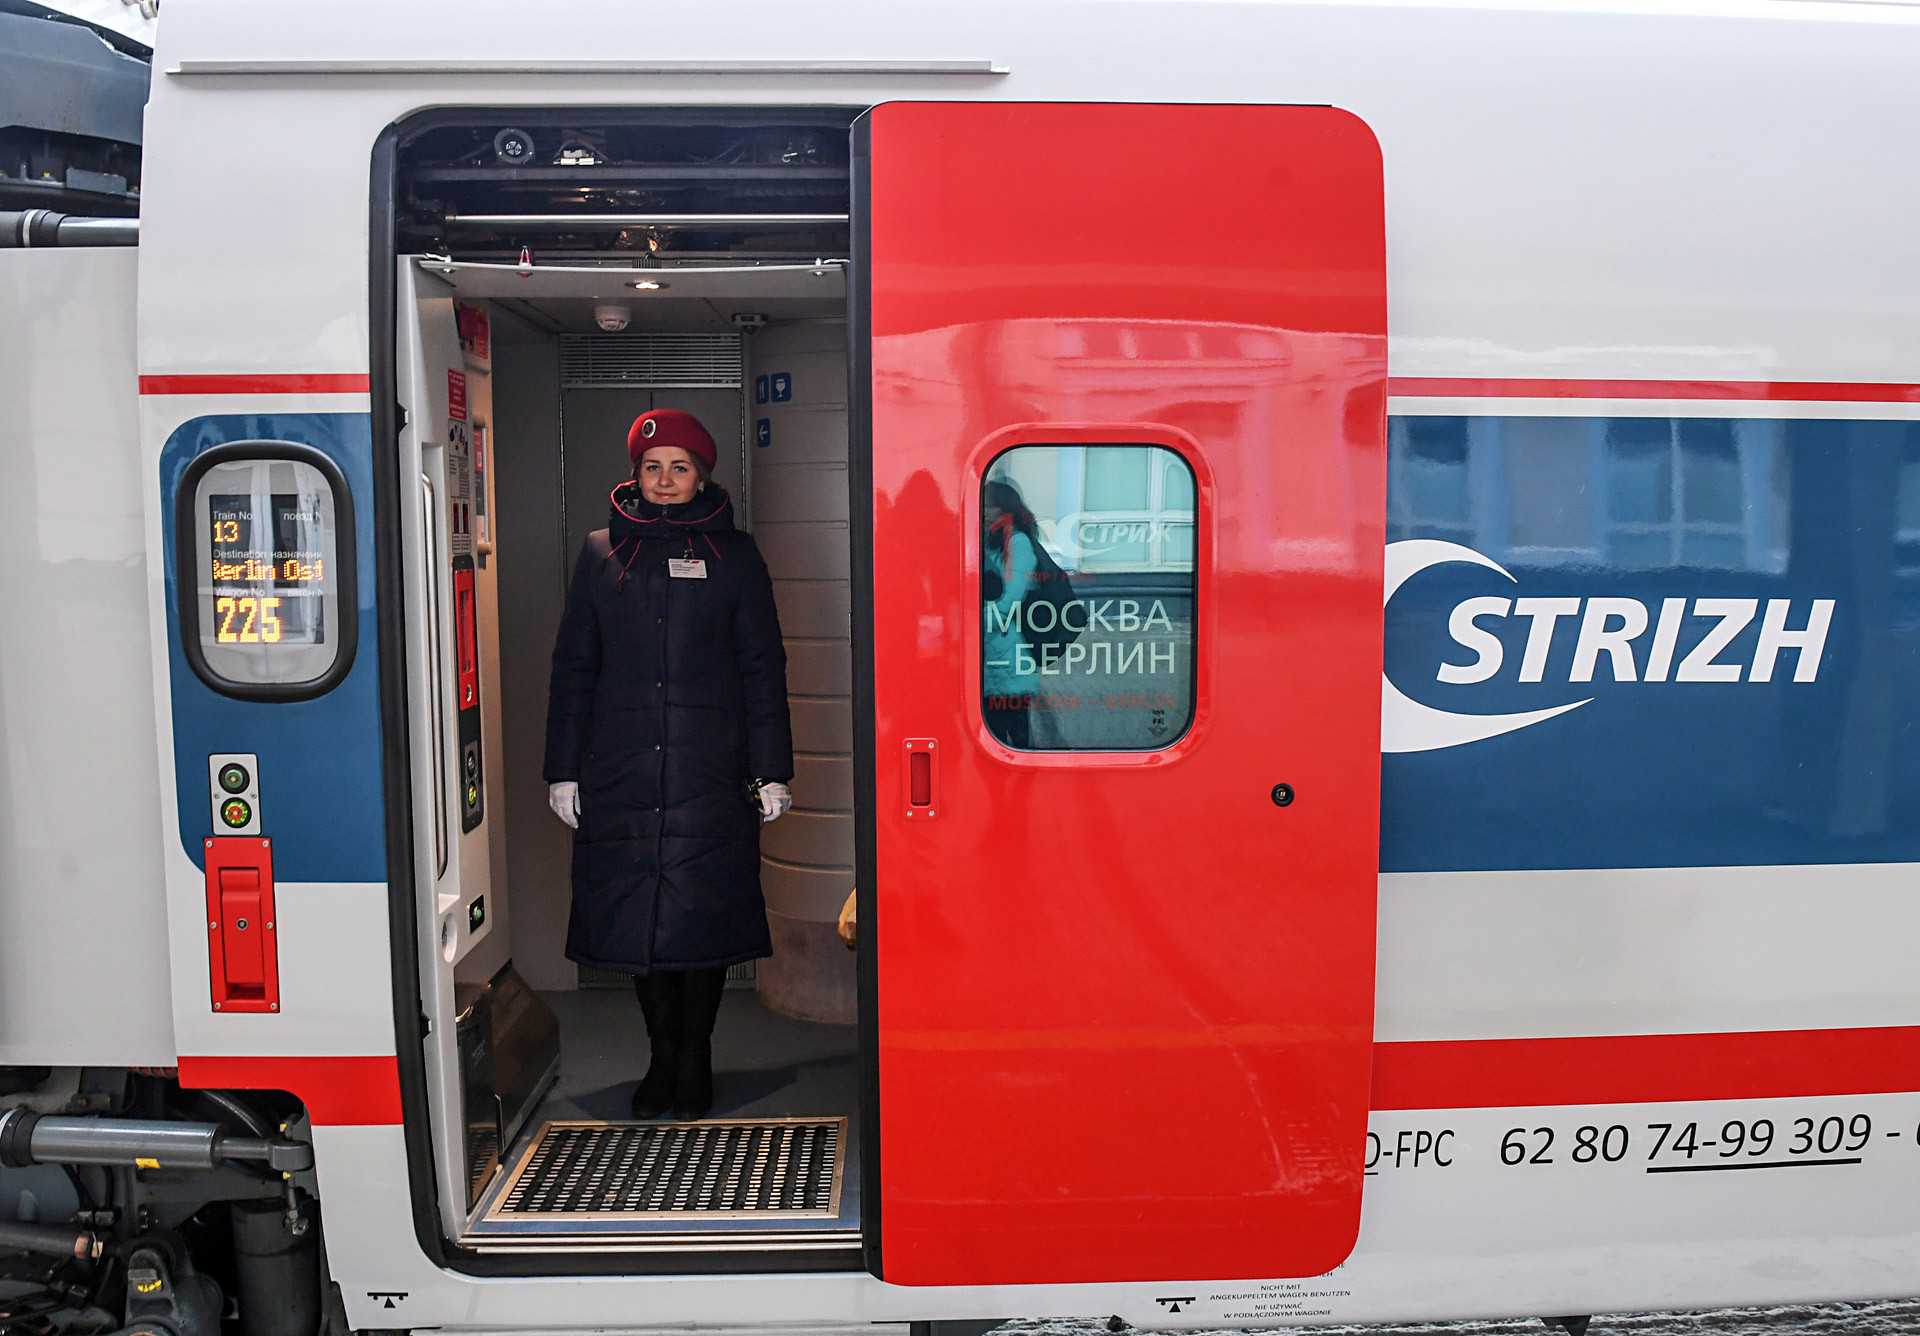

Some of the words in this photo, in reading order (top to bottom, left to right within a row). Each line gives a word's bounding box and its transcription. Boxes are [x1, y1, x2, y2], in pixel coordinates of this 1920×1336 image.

[213, 510, 236, 521] Train
[238, 511, 253, 521] No
[213, 520, 240, 543] 13
[1079, 523, 1174, 543] СТРИЖ
[213, 549, 267, 559] Destination
[216, 588, 250, 599] Wagon
[250, 588, 266, 598] No
[216, 597, 282, 643] 225
[986, 599, 1173, 633] МОСКВА
[1436, 595, 1836, 684] STRIZH
[988, 694, 1082, 711] MOSCOW
[1106, 693, 1175, 709] BERLIN
[1500, 1126, 1554, 1166] 62
[1571, 1124, 1629, 1164] 80
[1646, 1118, 1774, 1161] 74-99
[1788, 1113, 1872, 1156] 309
[1209, 1293, 1277, 1301] ANGEKUPPELTEM
[1278, 1291, 1308, 1299] WAGEN
[1310, 1290, 1351, 1298] BENUTZEN
[1294, 1309, 1332, 1317] WAGONIE
